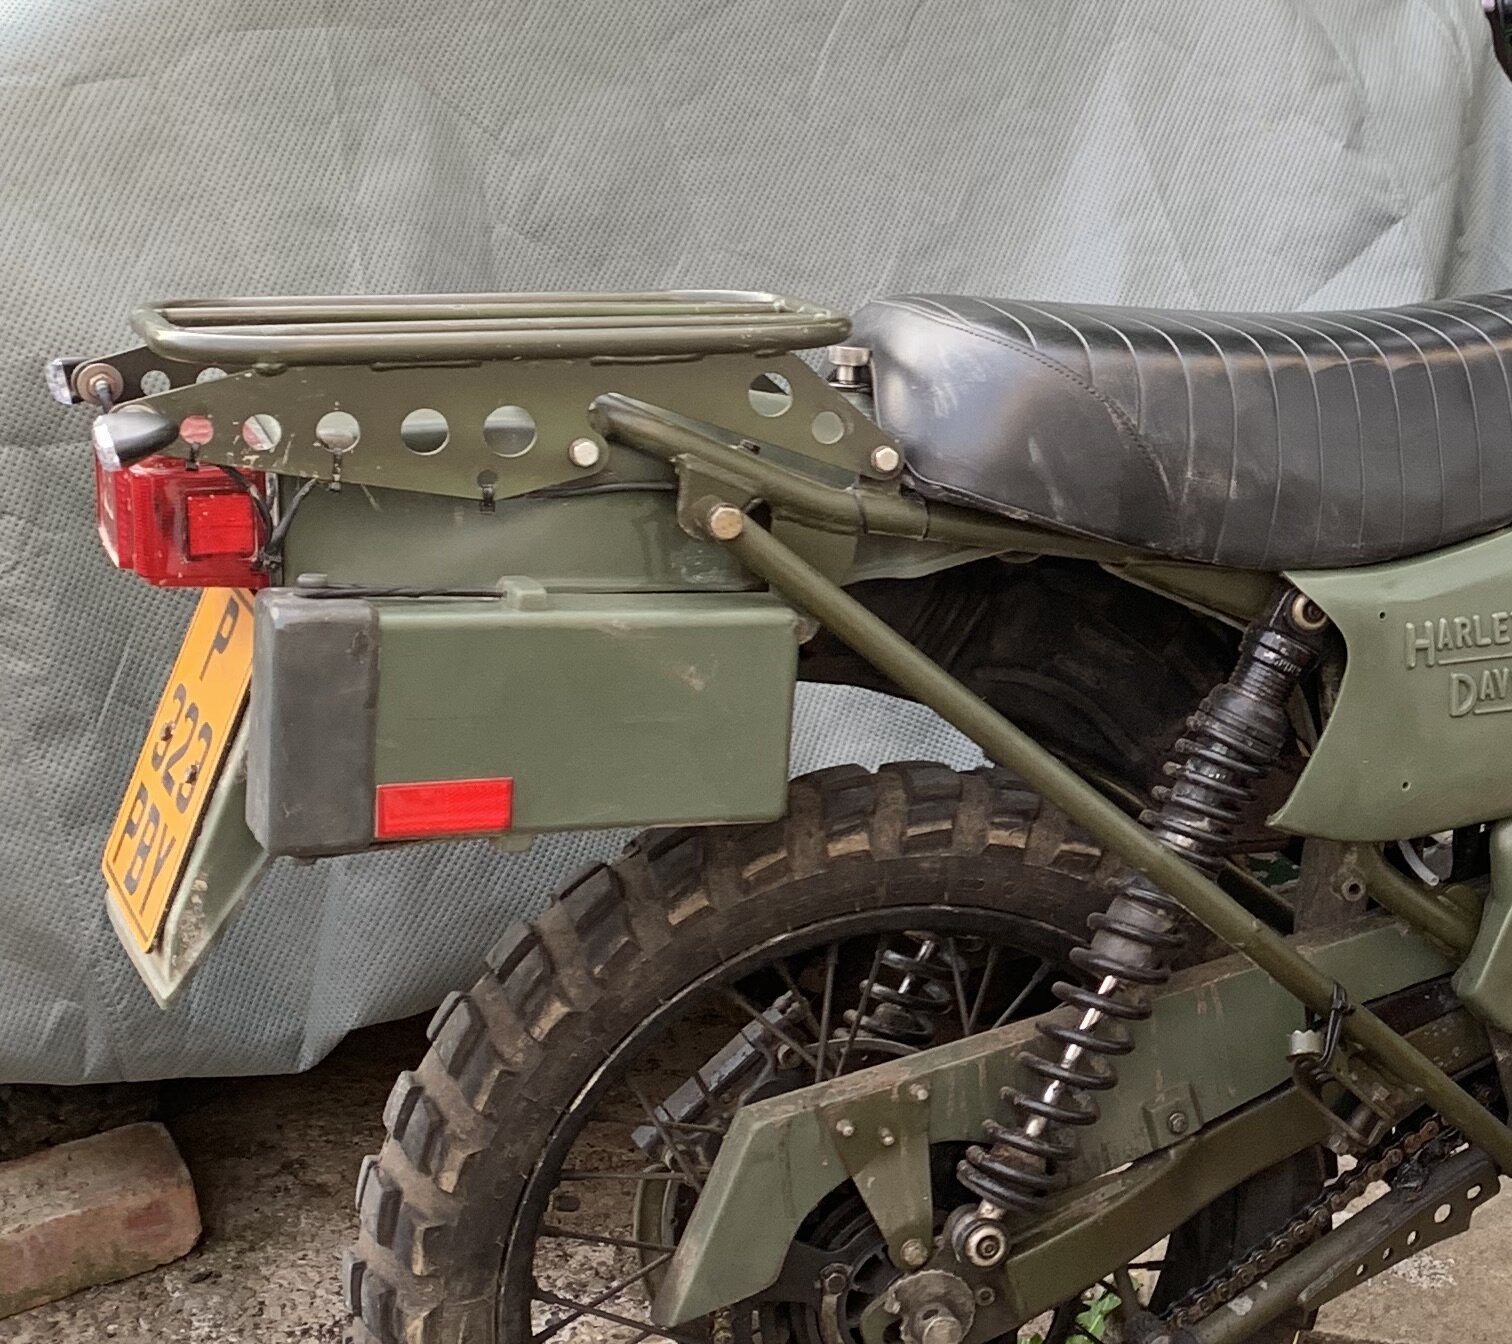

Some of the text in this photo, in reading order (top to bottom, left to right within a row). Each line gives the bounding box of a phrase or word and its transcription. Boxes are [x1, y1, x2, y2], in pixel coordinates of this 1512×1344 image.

[200, 596, 239, 681] P
[151, 683, 213, 814] 323
[113, 782, 177, 916] PBY
